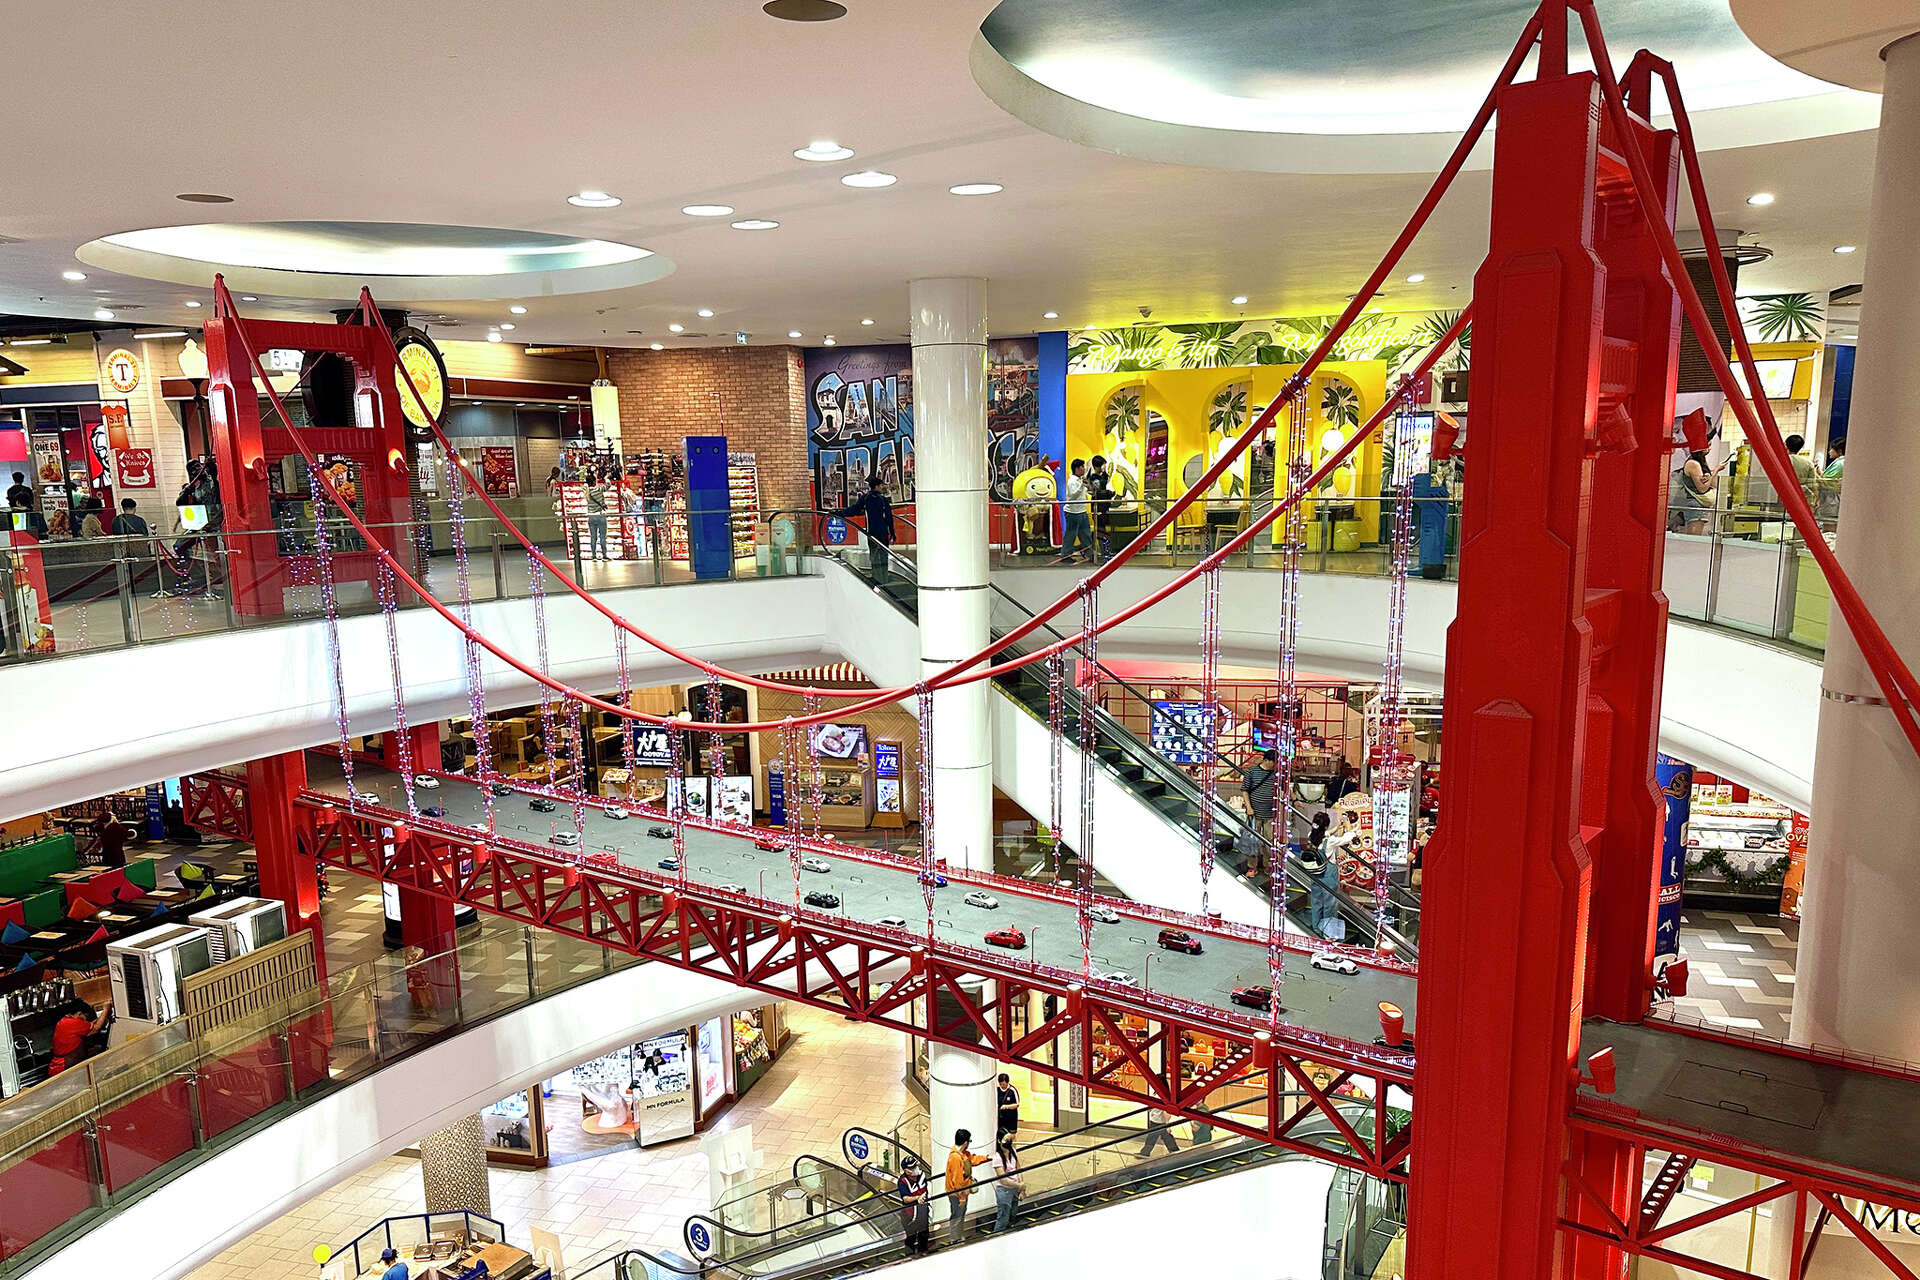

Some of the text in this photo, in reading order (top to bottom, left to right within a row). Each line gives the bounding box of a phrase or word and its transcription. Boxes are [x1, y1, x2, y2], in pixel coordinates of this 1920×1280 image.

[1281, 328, 1435, 357] Mgonificent
[1088, 338, 1219, 367] Mango is life
[115, 363, 129, 381] T
[838, 353, 880, 374] Greetings
[814, 371, 899, 445] SAN
[50, 442, 59, 451] 69
[1659, 885, 1681, 896] ALL
[657, 1097, 685, 1108] FORMULA
[695, 1227, 704, 1243] 3
